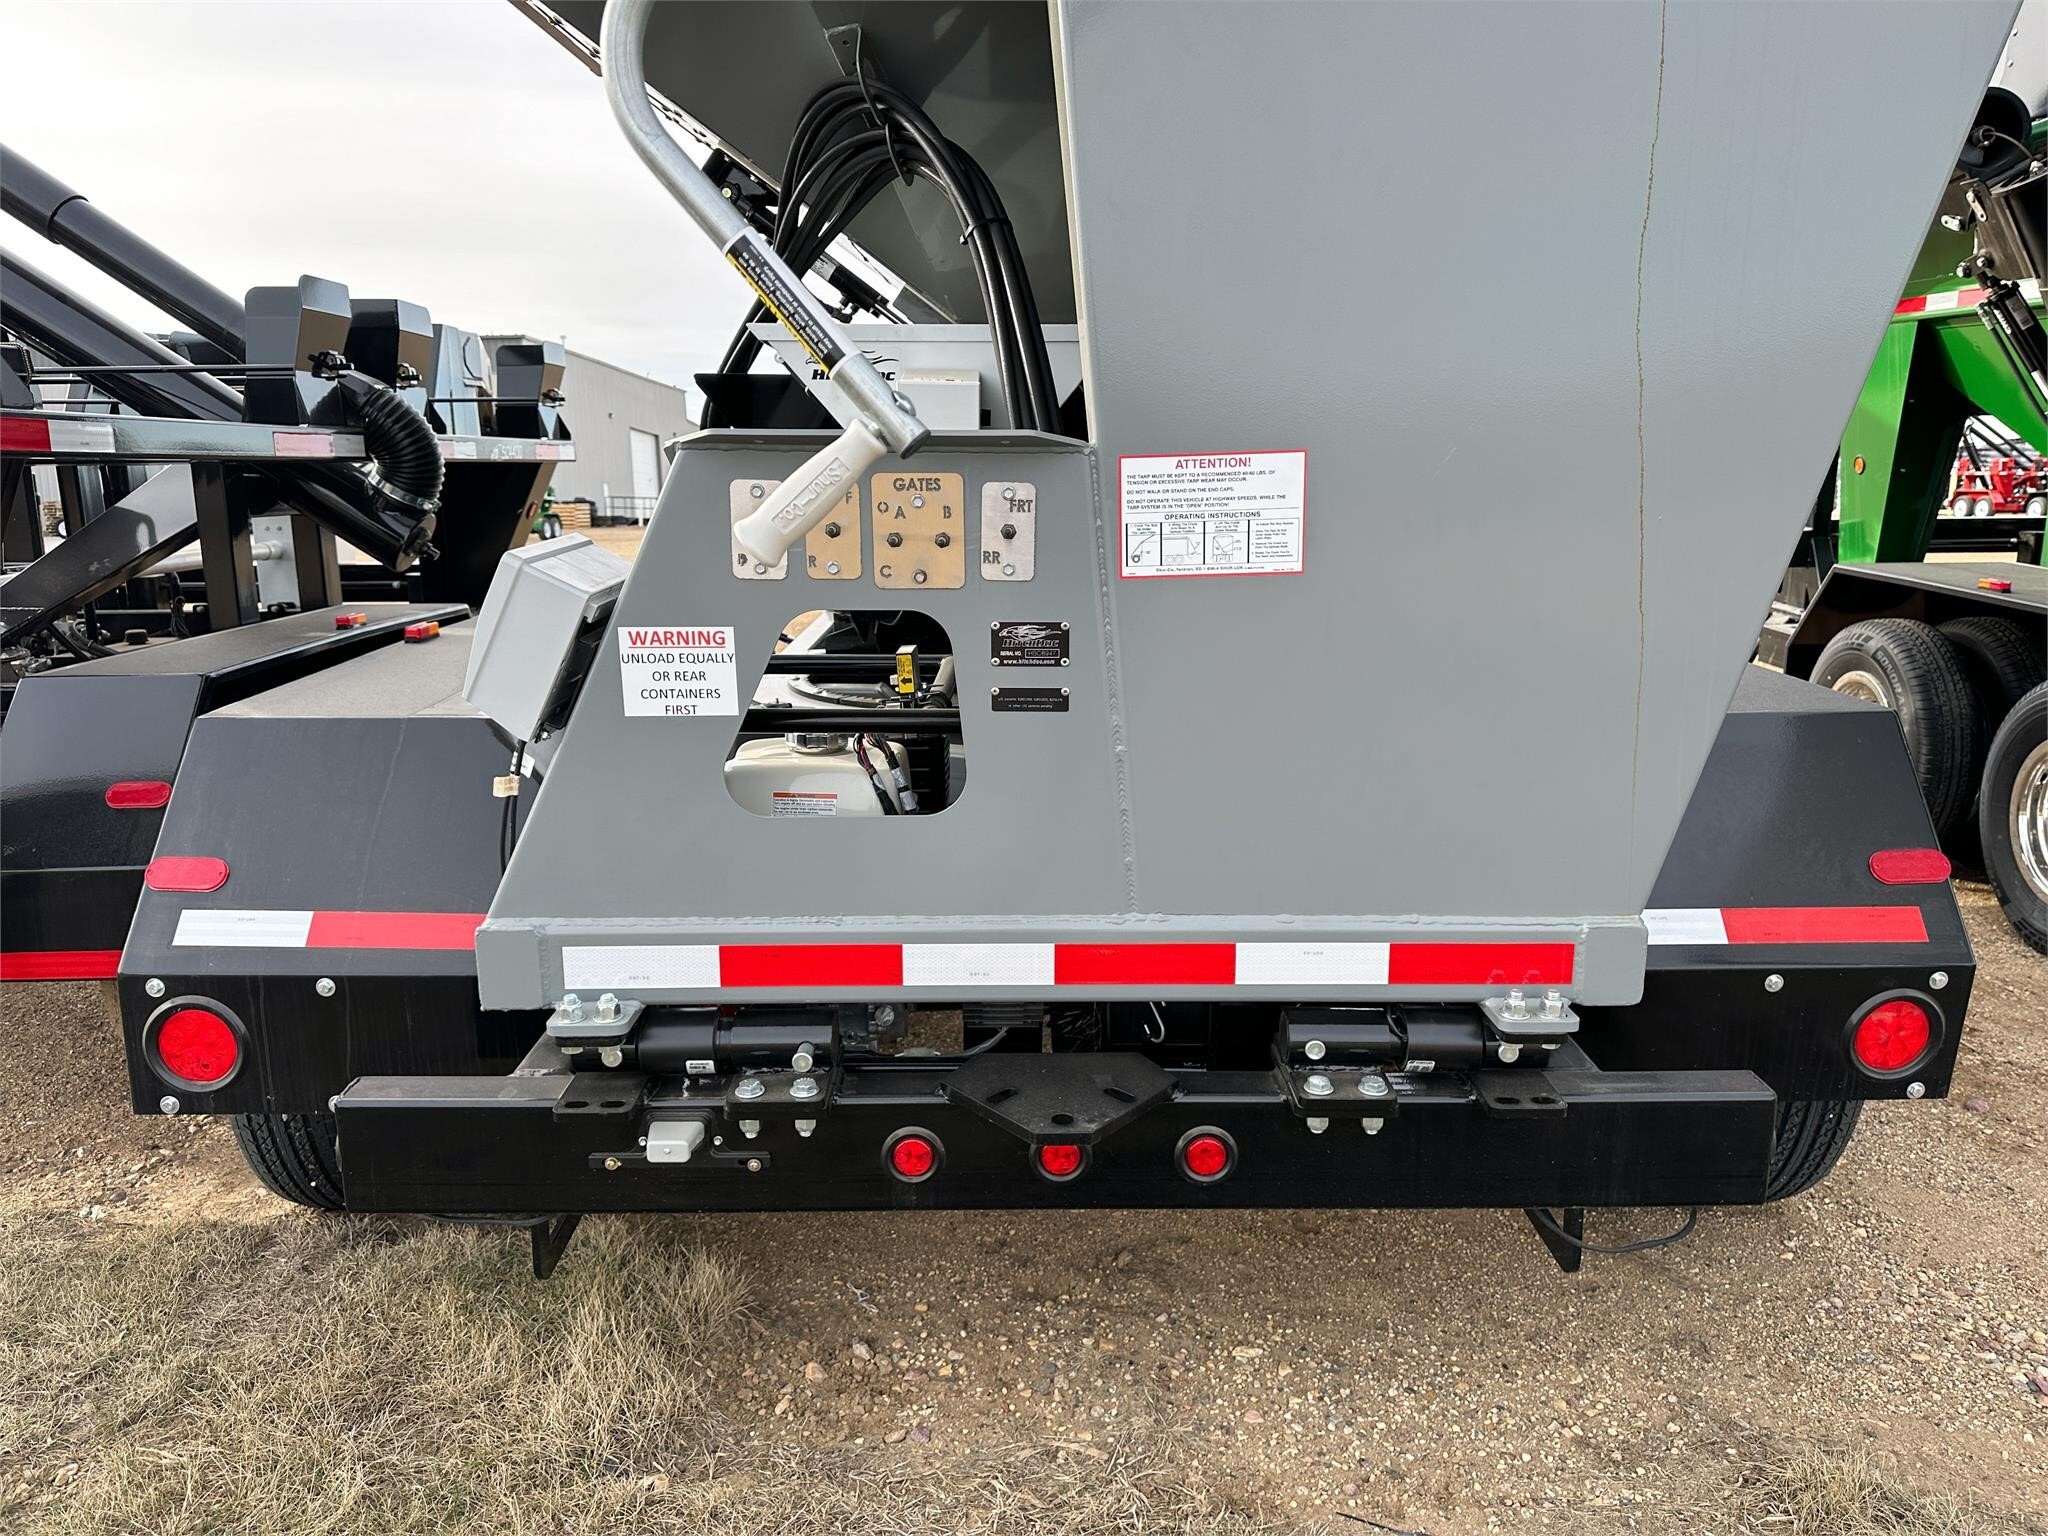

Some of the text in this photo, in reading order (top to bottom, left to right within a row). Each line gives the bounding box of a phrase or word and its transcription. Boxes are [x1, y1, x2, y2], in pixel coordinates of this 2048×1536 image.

[1175, 457, 1251, 470] ATTENTION!
[893, 478, 941, 492] GATES
[894, 506, 906, 519] A
[943, 506, 952, 519] B
[1009, 499, 1034, 513] FRT
[1207, 511, 1261, 519] INSTRUCTIONS
[808, 555, 817, 568] R
[983, 551, 1001, 565] RR
[880, 565, 892, 578] C
[628, 630, 726, 646] WARNING
[621, 653, 735, 665] UNLOAD EQUALLY
[652, 671, 707, 682] OR REAR
[640, 688, 721, 699] CONTAINERS
[665, 704, 698, 715] FIRST
